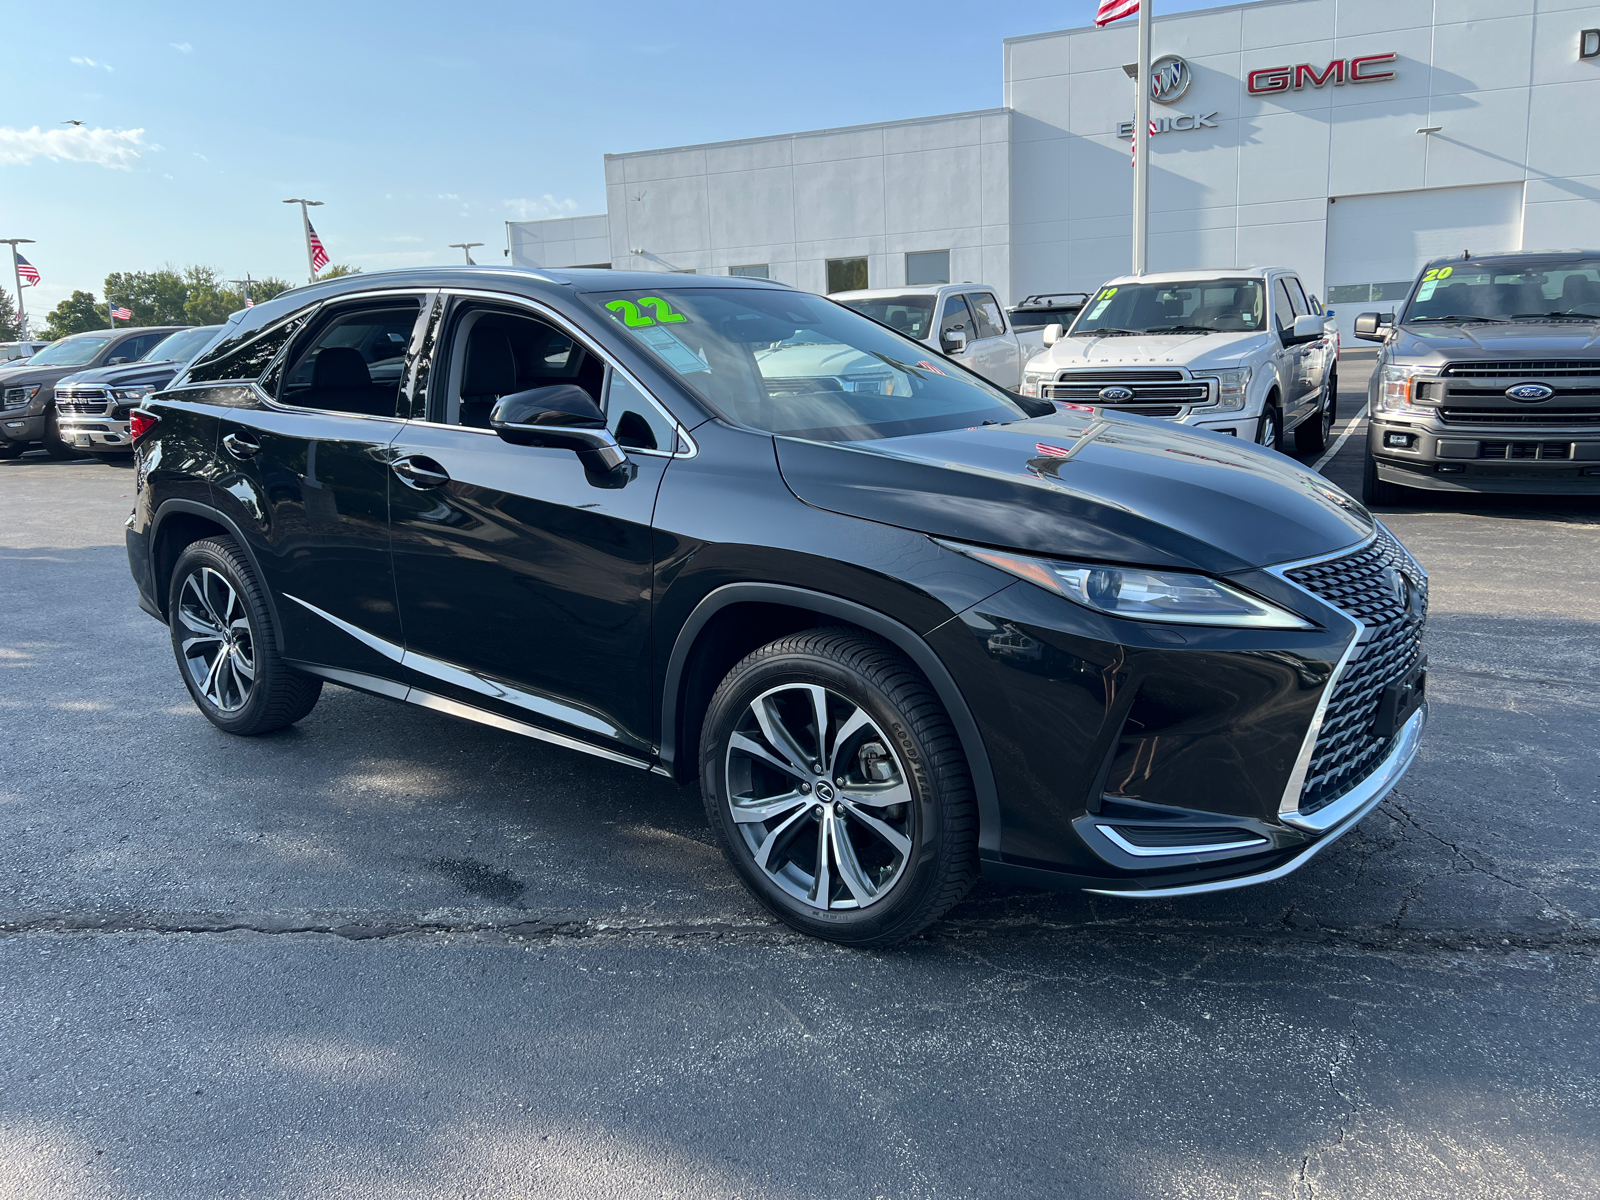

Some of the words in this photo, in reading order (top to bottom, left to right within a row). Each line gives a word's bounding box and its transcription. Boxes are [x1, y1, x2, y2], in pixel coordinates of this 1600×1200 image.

[1247, 52, 1397, 96] GMC
[1422, 266, 1453, 282] 20
[1097, 287, 1118, 301] 19
[605, 297, 688, 328] 22
[65, 397, 90, 405] RAM
[892, 722, 932, 805] GOODYEAR
